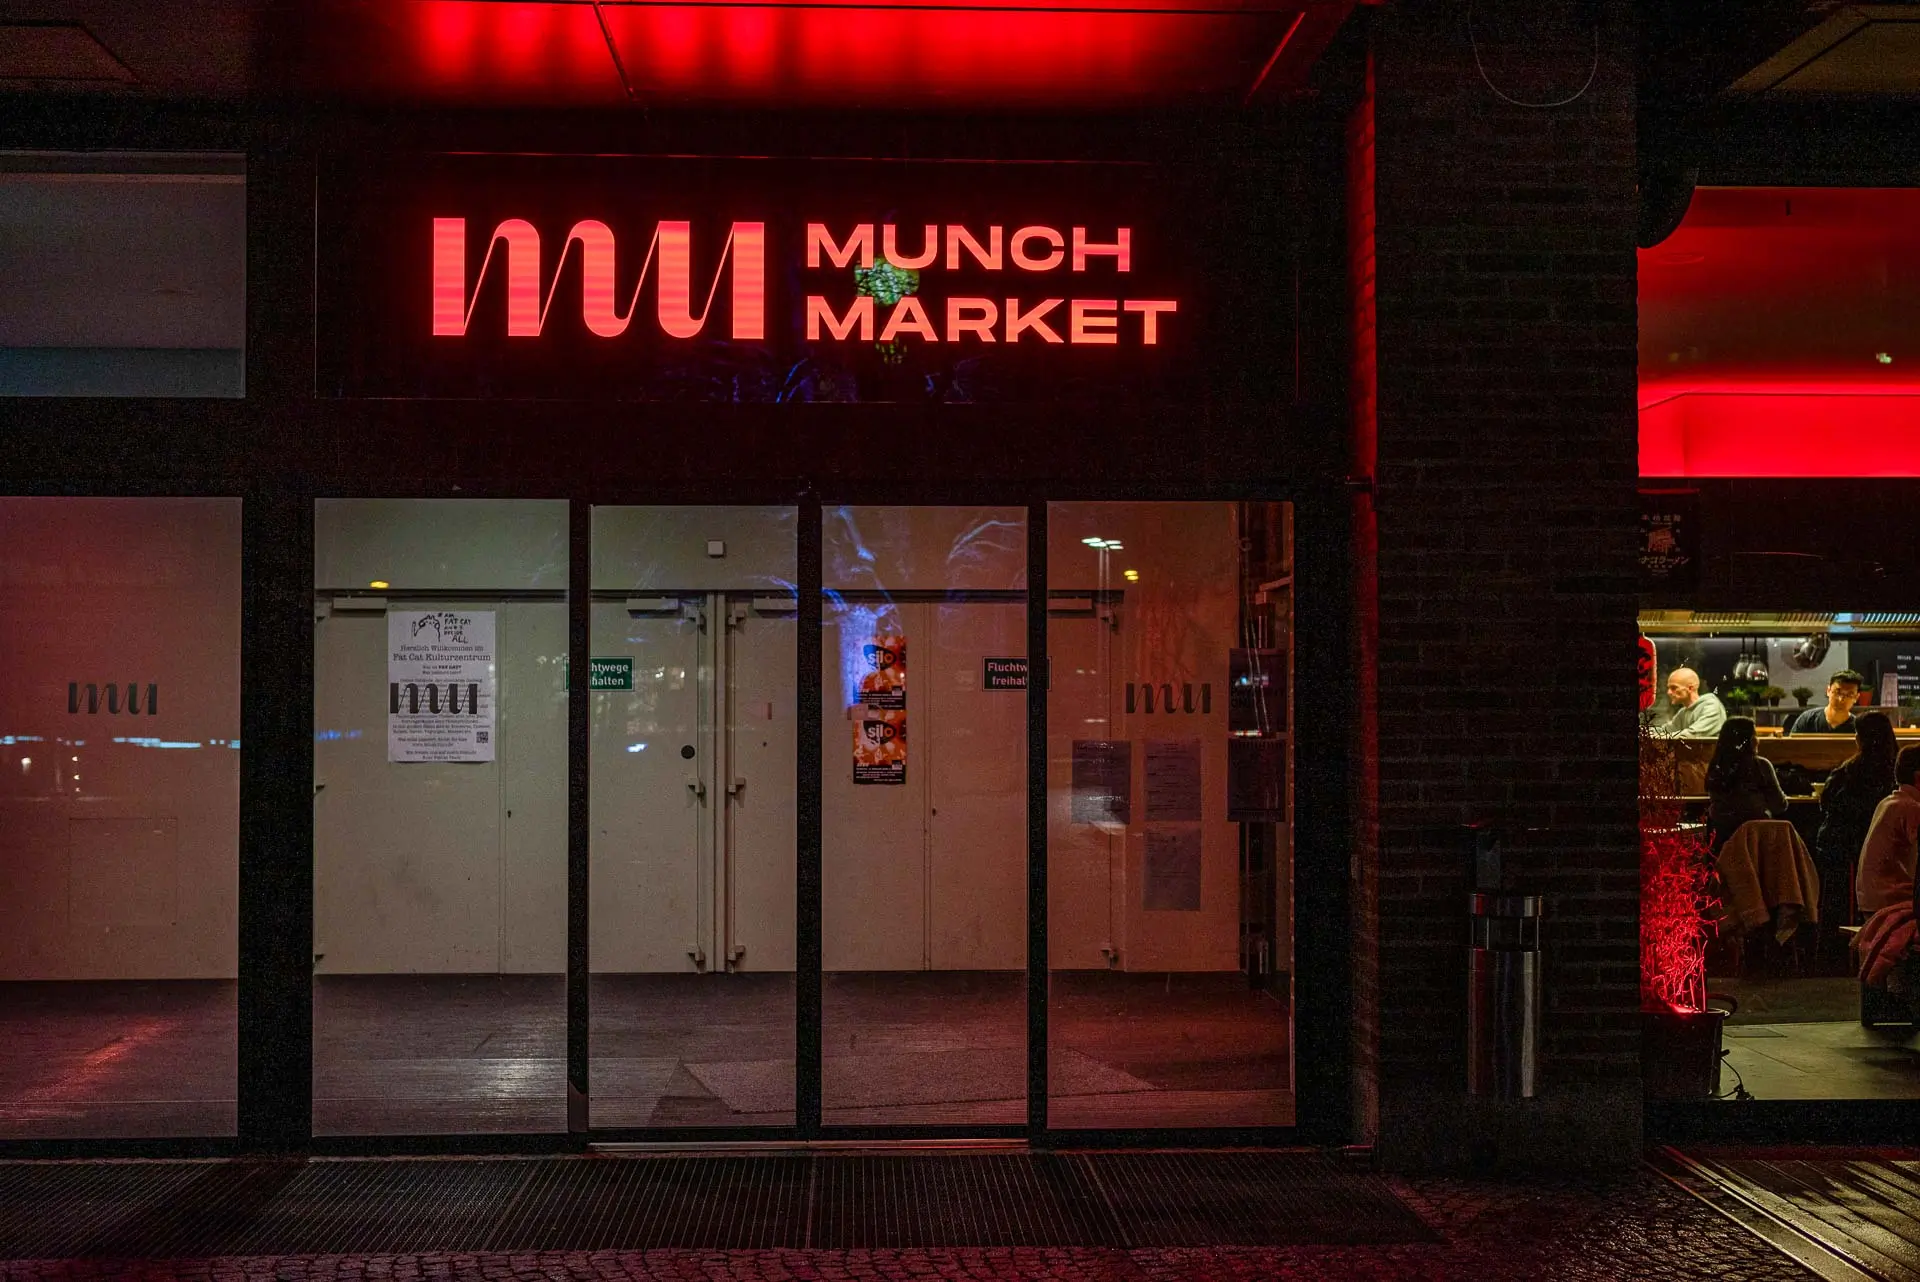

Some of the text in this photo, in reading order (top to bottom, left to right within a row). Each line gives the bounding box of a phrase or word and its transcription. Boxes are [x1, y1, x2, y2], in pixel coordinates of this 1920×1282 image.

[807, 223, 1131, 272] MUNCH
[807, 296, 1178, 345] MARKET
[452, 635, 469, 644] ALL
[400, 645, 430, 653] Herzlich
[393, 653, 491, 661] Fat Cat Kulturzentrum
[591, 662, 629, 674] htwege
[987, 662, 1028, 672] Fluchtw
[591, 676, 624, 685] halten
[992, 675, 1027, 685] freihal
[868, 724, 894, 737] silo
